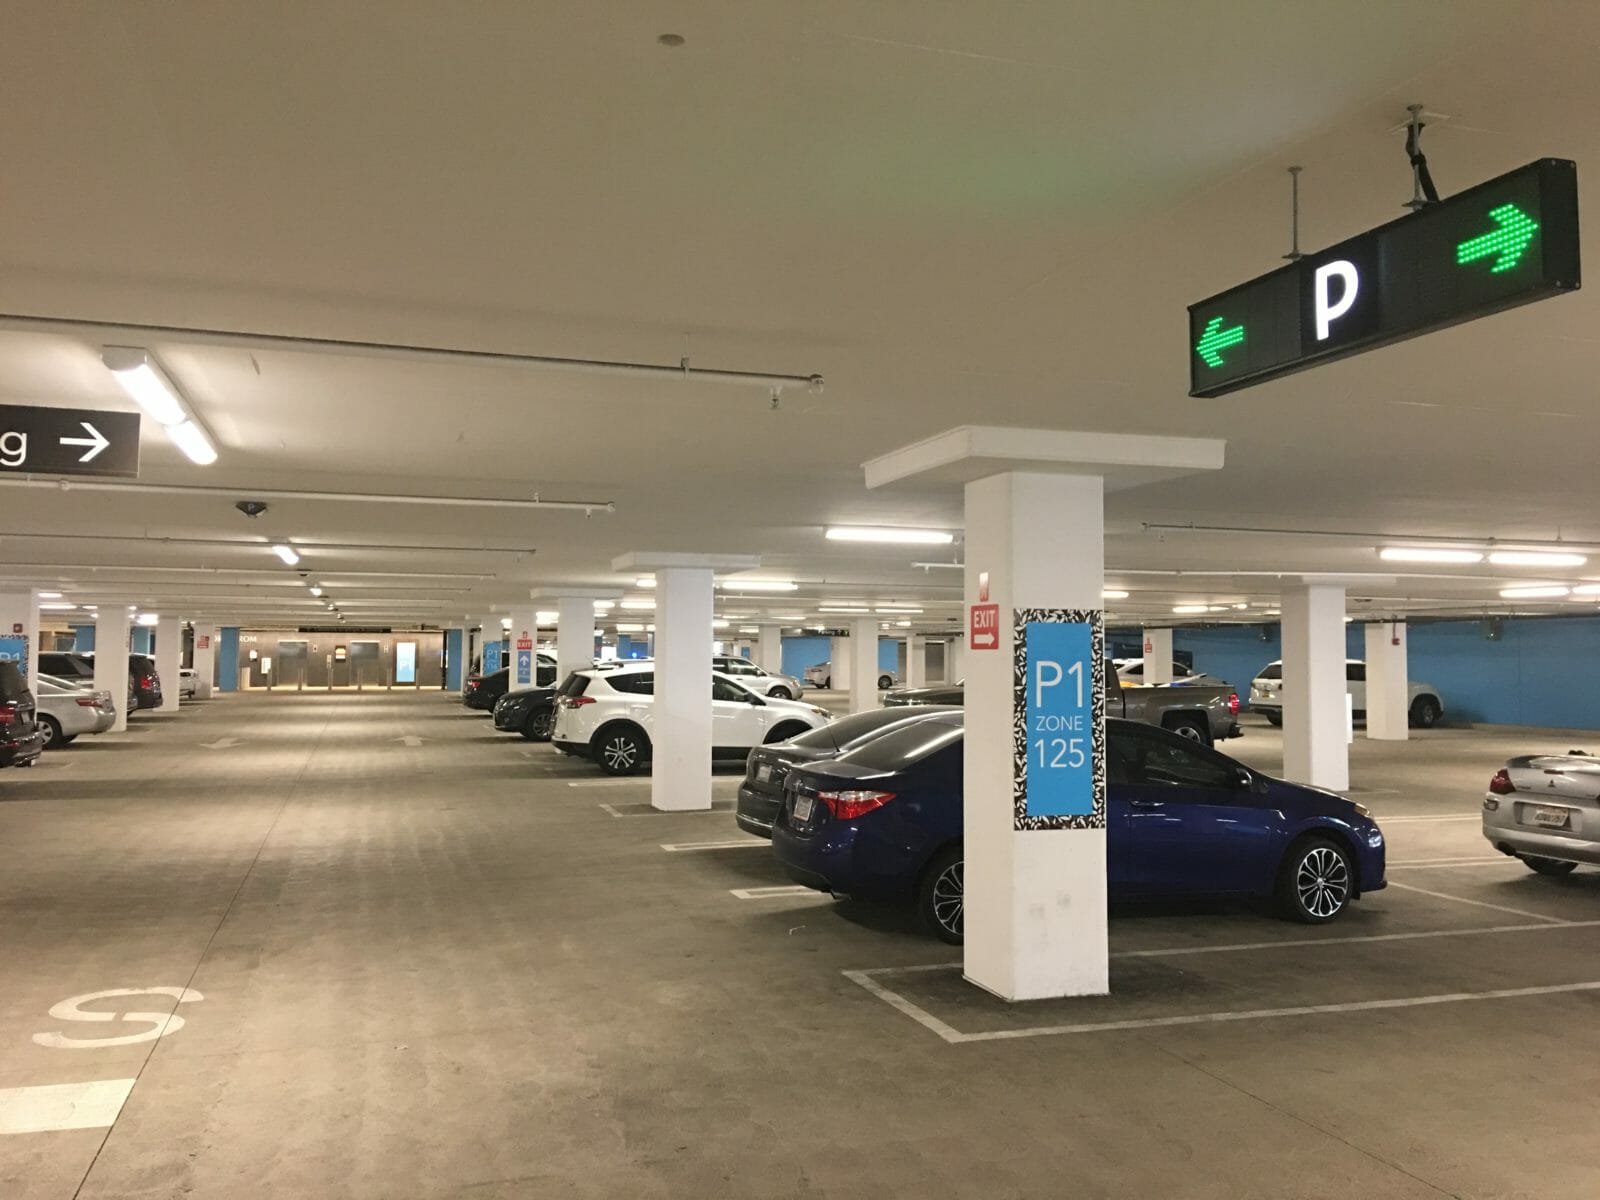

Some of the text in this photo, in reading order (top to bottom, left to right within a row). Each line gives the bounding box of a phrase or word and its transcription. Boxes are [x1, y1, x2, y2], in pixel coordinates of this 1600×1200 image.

[1315, 260, 1359, 340] P
[974, 610, 995, 628] EXIT
[1036, 661, 1083, 708] P1
[1035, 715, 1083, 731] ZONE
[1034, 739, 1084, 768] 125
